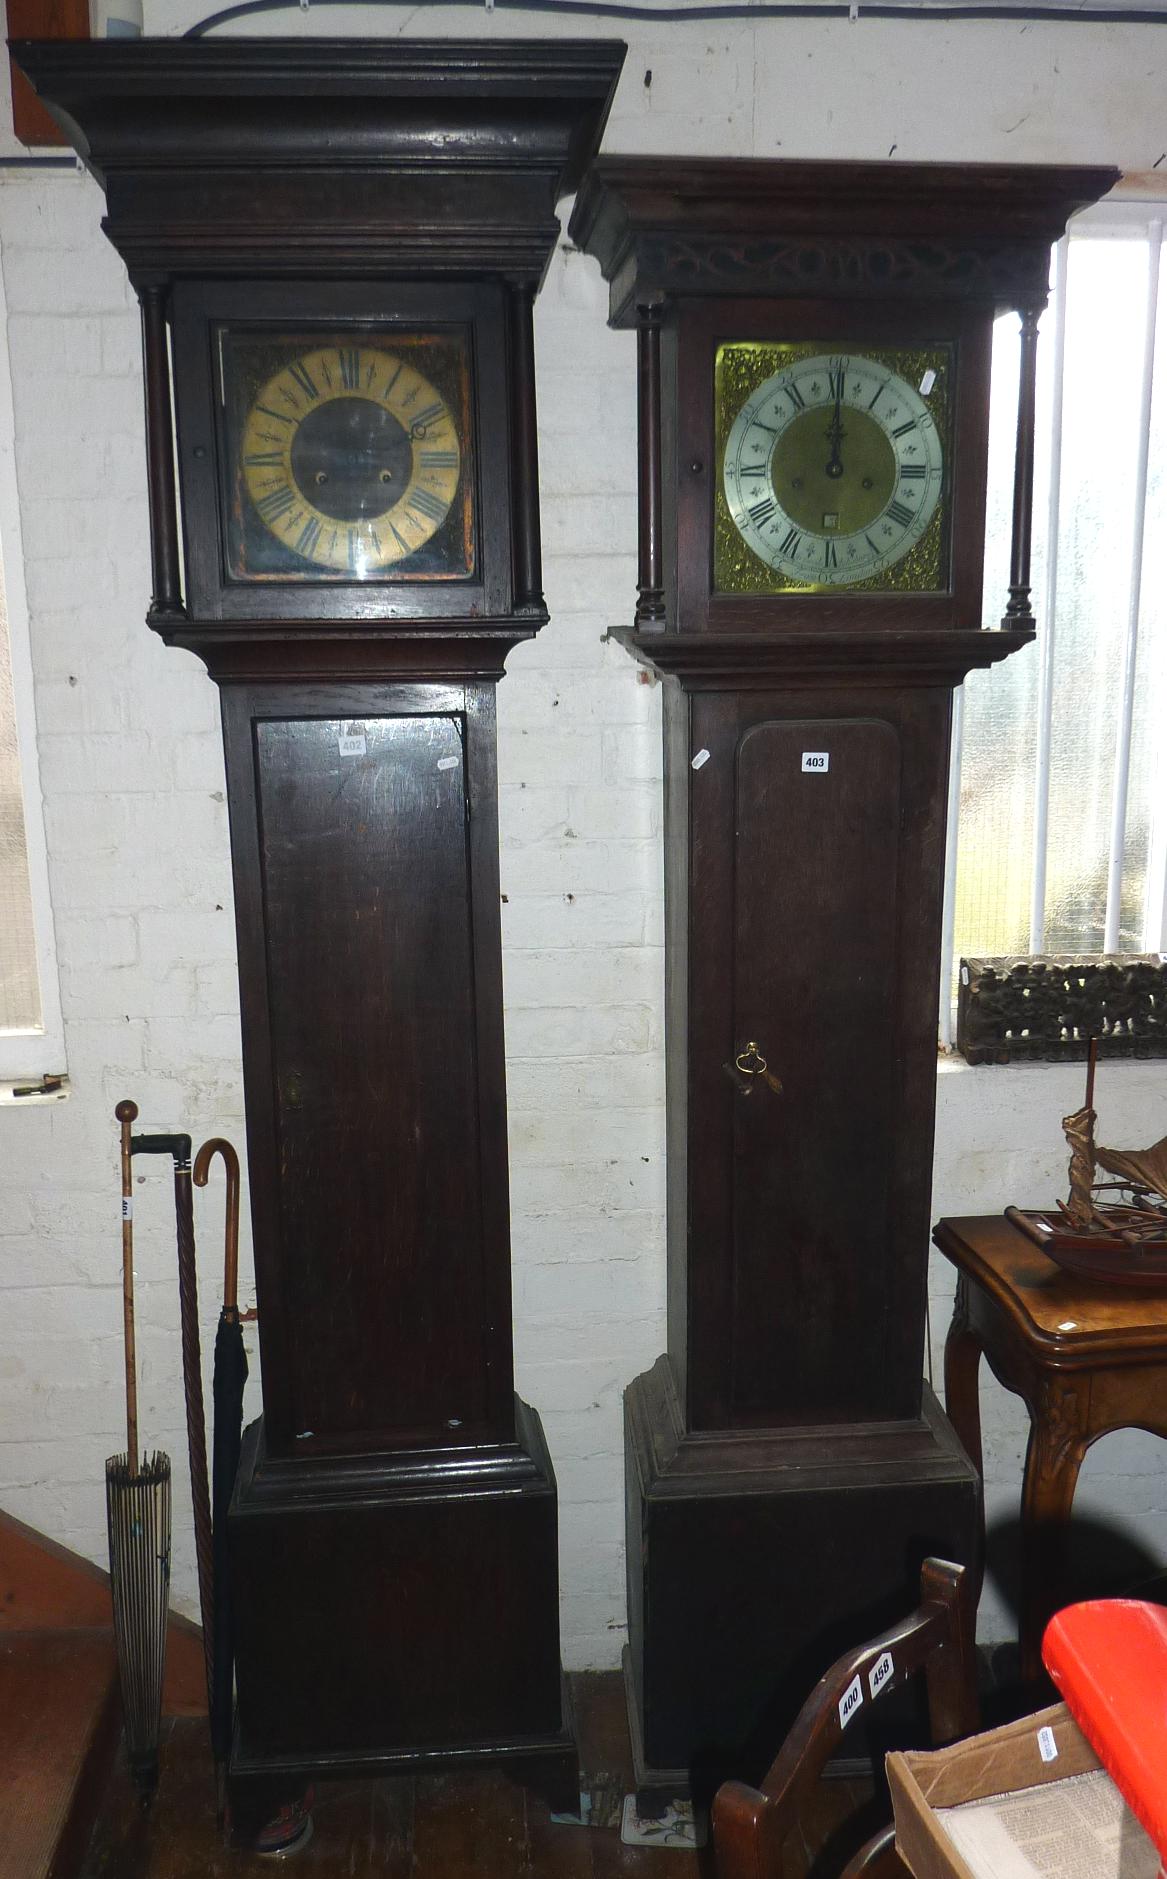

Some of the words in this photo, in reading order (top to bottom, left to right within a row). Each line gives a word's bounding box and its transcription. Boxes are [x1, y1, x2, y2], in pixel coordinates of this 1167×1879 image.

[343, 741, 363, 751] 402
[806, 757, 824, 767] 403
[873, 1658, 890, 1686] 458
[843, 1687, 858, 1715] 400
